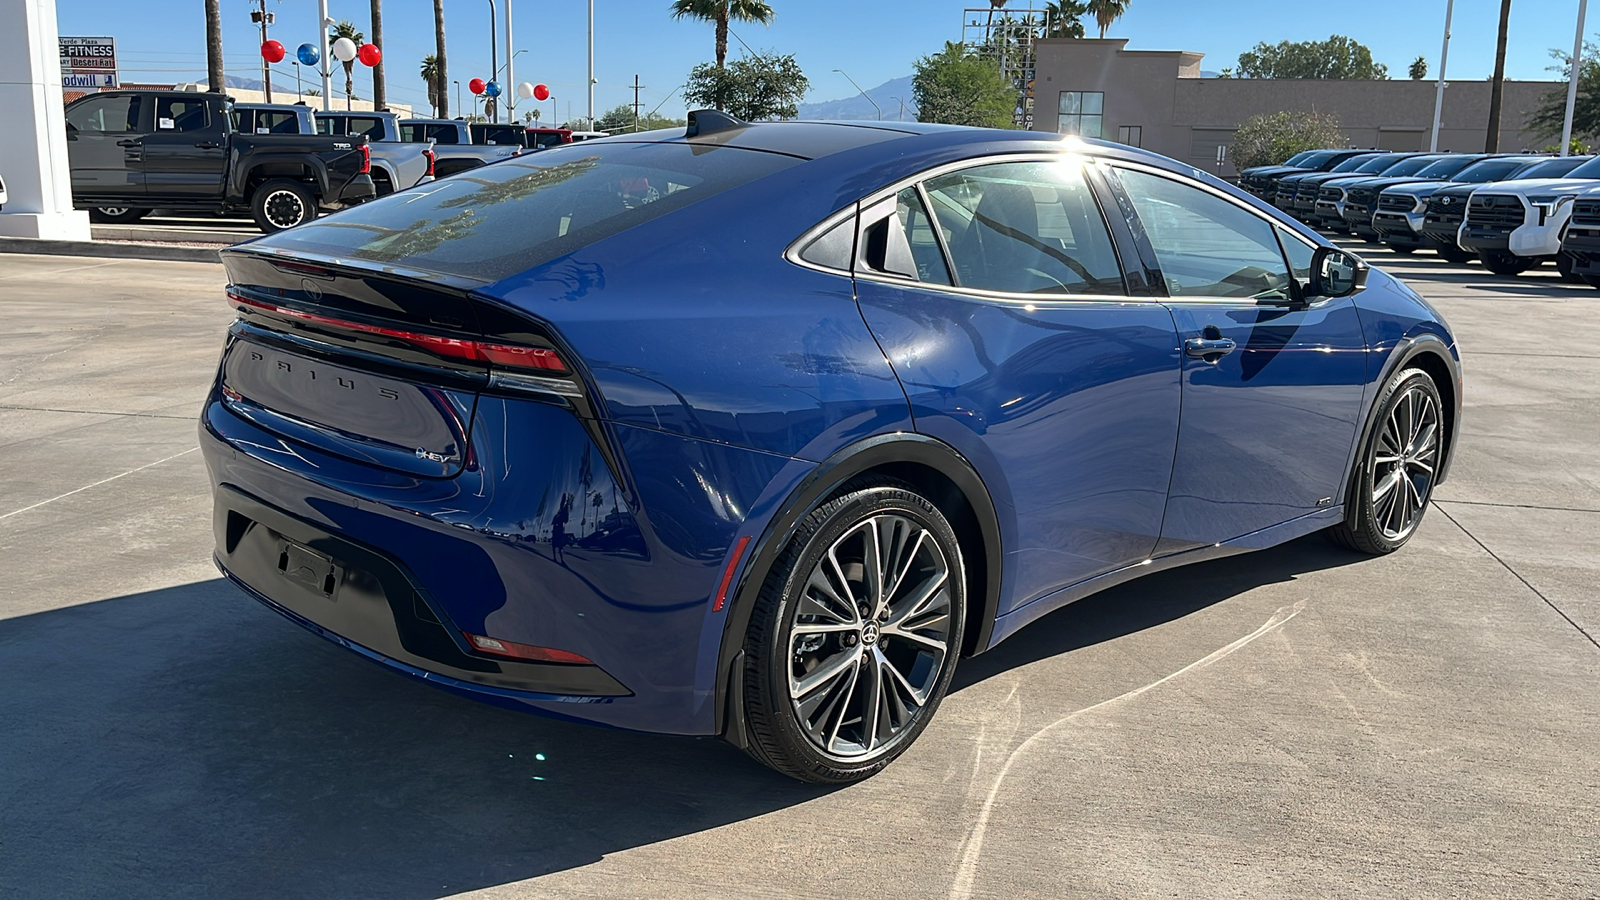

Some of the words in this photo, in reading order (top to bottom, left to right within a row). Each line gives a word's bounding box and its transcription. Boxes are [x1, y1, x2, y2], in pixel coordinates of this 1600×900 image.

[68, 46, 112, 56] FITNESS
[62, 75, 96, 86] odwill
[251, 352, 398, 400] PRIUS
[882, 491, 931, 512] MICHELIN
